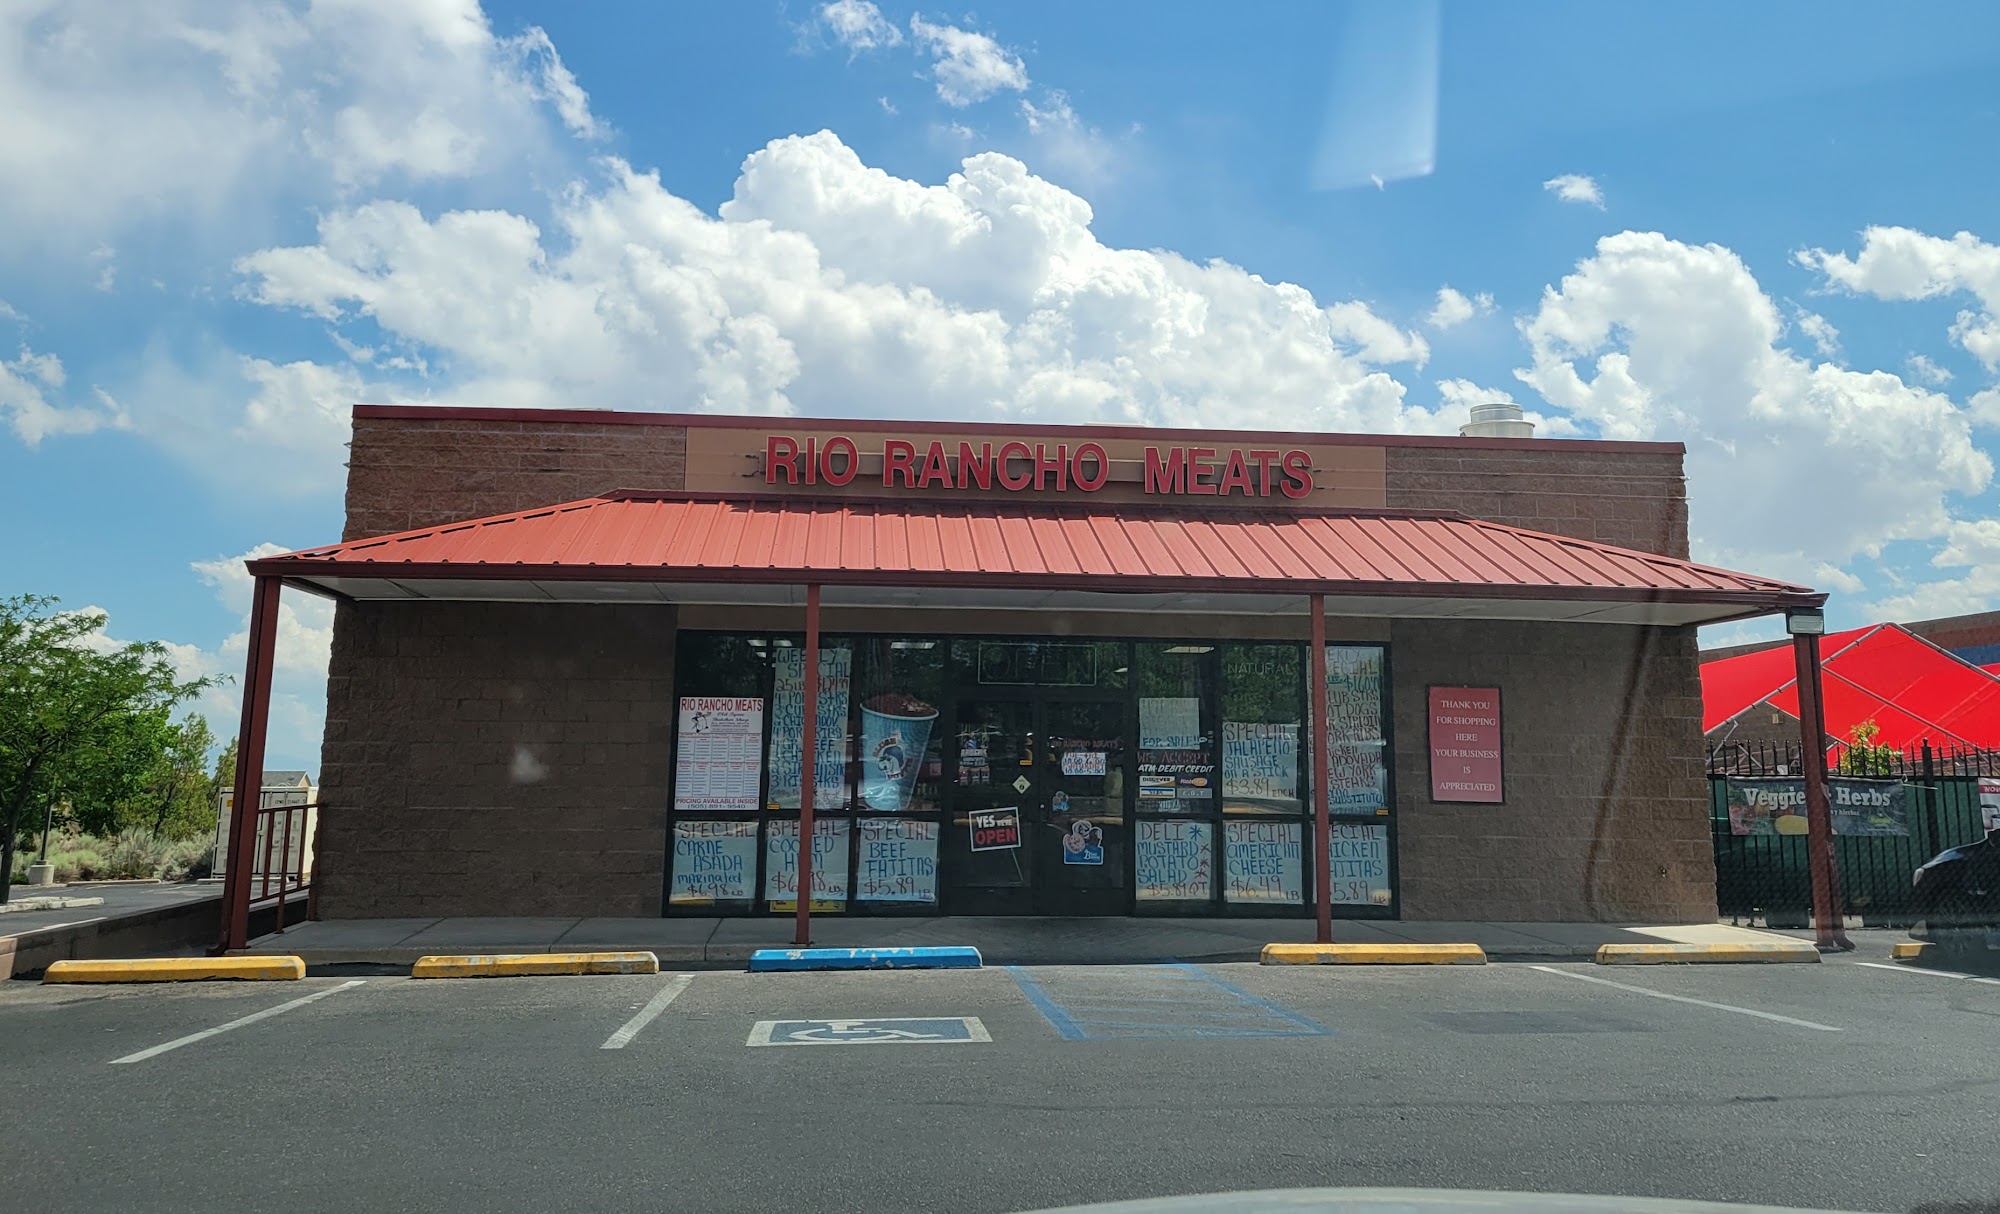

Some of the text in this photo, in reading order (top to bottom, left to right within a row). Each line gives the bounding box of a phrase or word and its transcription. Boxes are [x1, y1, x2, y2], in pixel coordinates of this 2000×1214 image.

[765, 435, 1314, 498] RIO RANCHO MEATS
[777, 649, 838, 664] WEELY
[788, 662, 850, 678] SPCIAL
[1227, 662, 1294, 676] NATURAL
[1330, 659, 1378, 676] ECIAL
[681, 698, 763, 712] RIO RANCHO MEATS
[1327, 702, 1378, 717] OT DOGS
[1440, 700, 1490, 710] THANK YOU
[1436, 716, 1496, 726] FOR SHOPPING
[1224, 723, 1290, 741] SPECIAL
[1327, 730, 1350, 744] ORK
[1455, 733, 1478, 742] HERE
[1161, 751, 1211, 764] ACCEPT
[1435, 748, 1499, 759] YOUR BUSINESS
[1242, 768, 1249, 778] A
[1463, 766, 1471, 774] IS
[1226, 777, 1270, 797] $3.89
[1440, 782, 1496, 791] APPRECIATED
[1835, 787, 1891, 806] Herbs
[678, 822, 756, 838] SPECIAL
[770, 820, 841, 837] SPEIAL
[976, 815, 996, 828] YES
[863, 820, 936, 841] SPECIAL
[975, 828, 1017, 846] OPEN
[1140, 823, 1185, 841] DELI
[1227, 823, 1300, 844] SPECIAL
[1330, 824, 1381, 842] ECIAL
[676, 839, 724, 856] CARNE
[769, 836, 835, 854] COOED
[867, 841, 907, 859] BEEF
[1137, 841, 1199, 856] MUSTARD
[693, 854, 743, 873] ASADA
[784, 852, 823, 872] HM
[864, 856, 934, 878] FAJITAS
[1139, 854, 1199, 870] POTATO
[1229, 858, 1284, 876] CHEESE
[1329, 859, 1383, 878] AJITAS
[1136, 868, 1188, 884] SALAD
[863, 876, 915, 897] $5.89
[1146, 882, 1187, 897] $5.89
[1231, 874, 1282, 898] $6.49
[1332, 880, 1369, 902] 5.89
